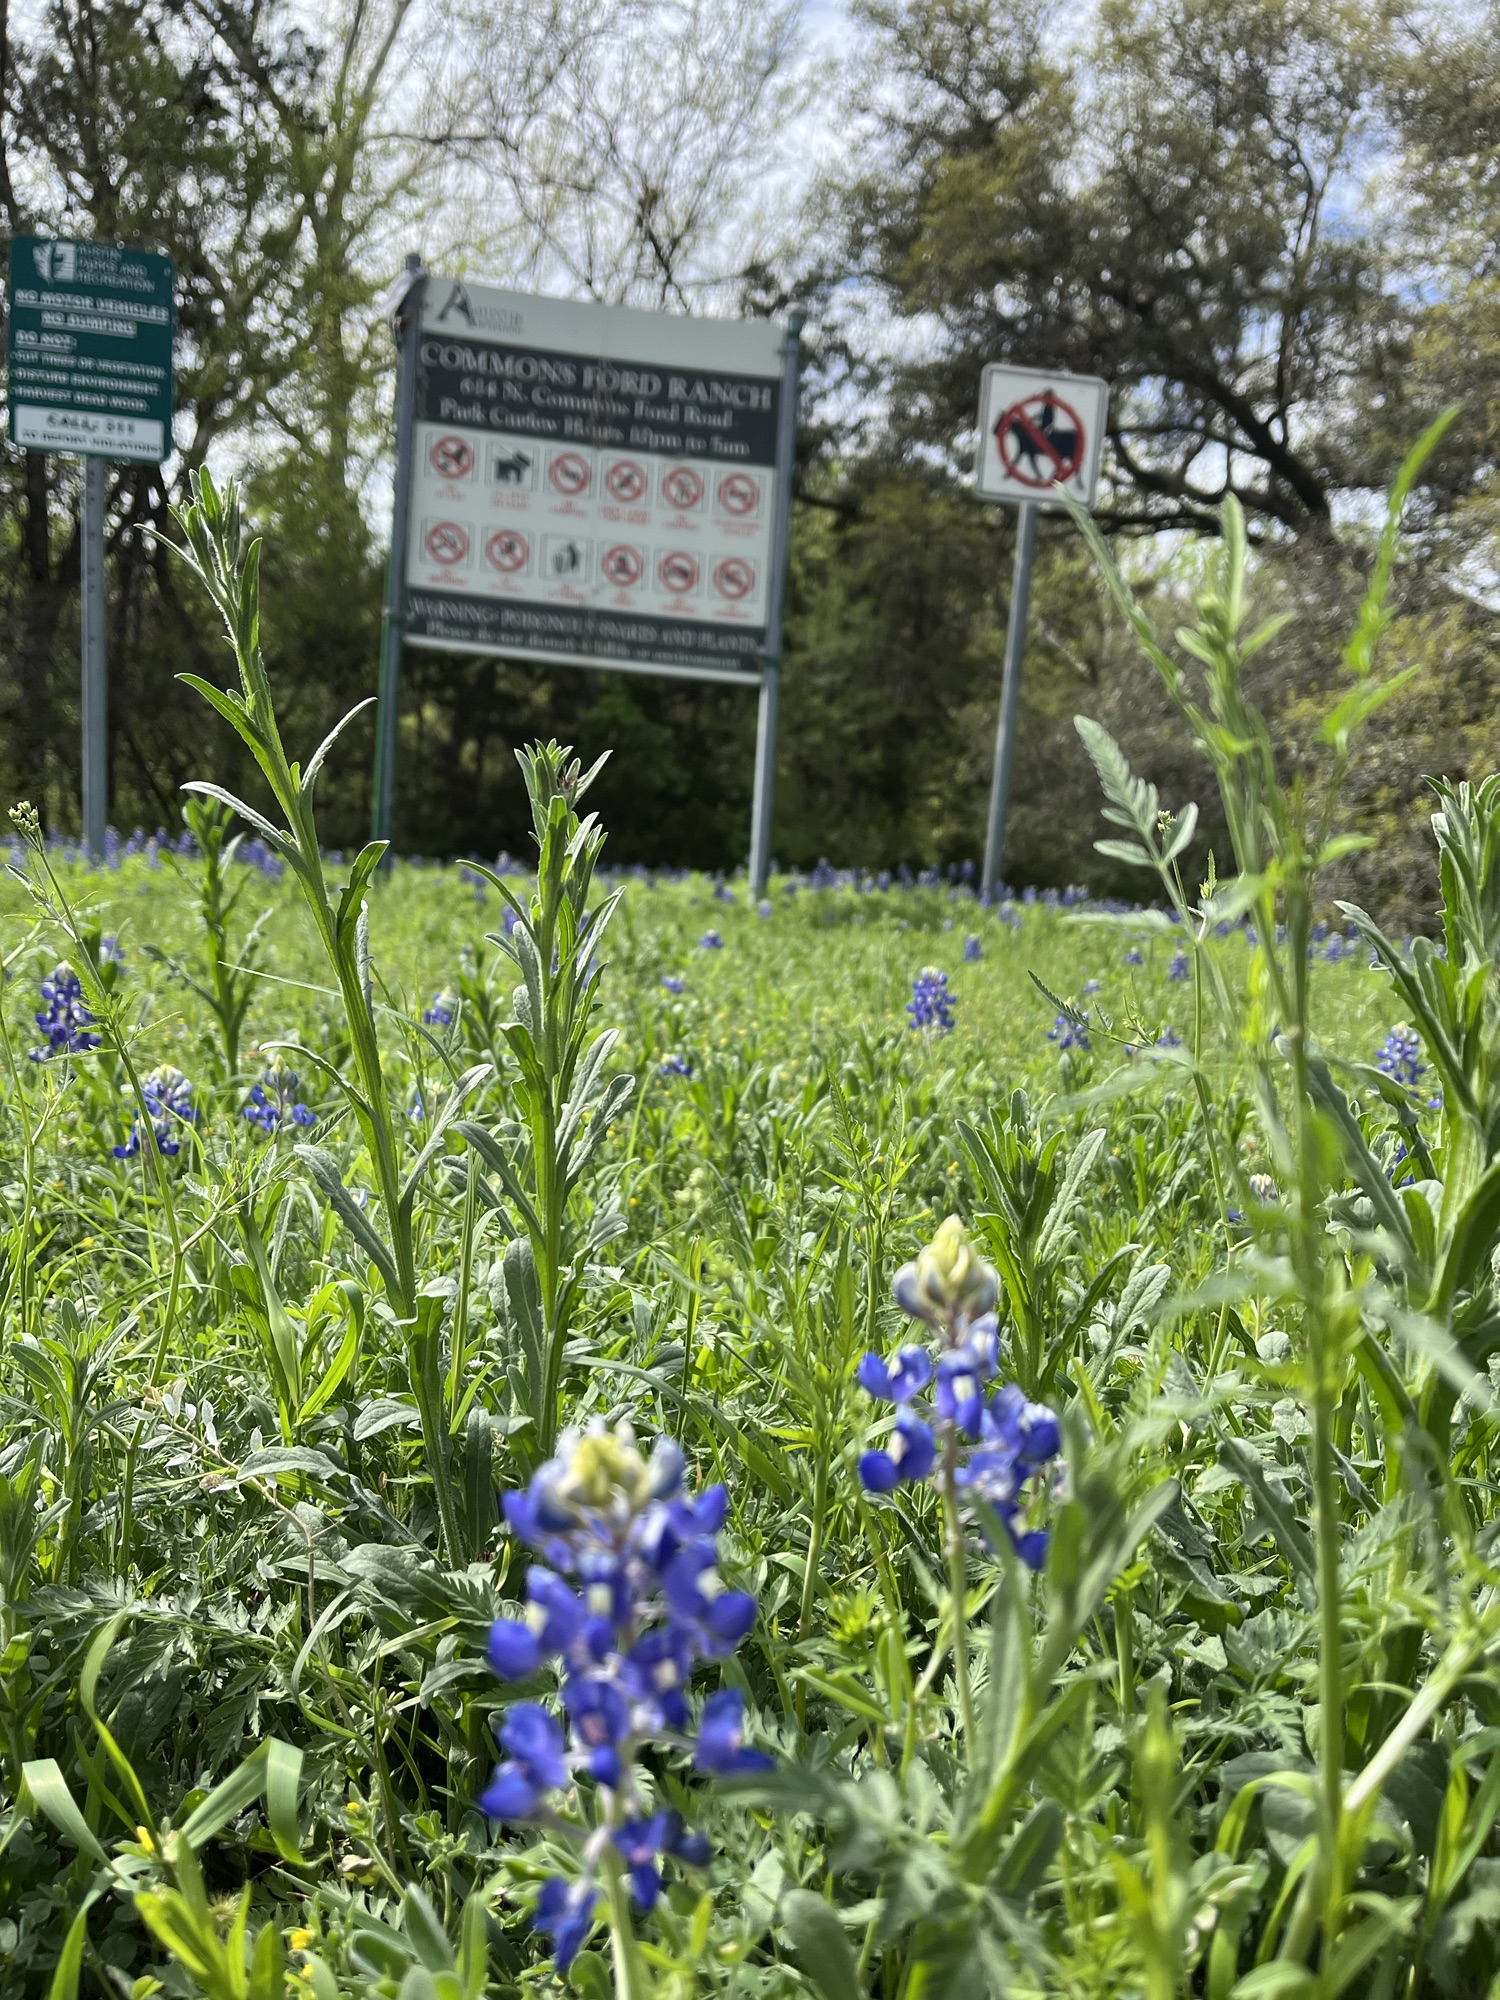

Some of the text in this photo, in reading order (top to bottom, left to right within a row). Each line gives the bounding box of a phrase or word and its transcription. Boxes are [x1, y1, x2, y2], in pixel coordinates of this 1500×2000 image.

[15, 289, 169, 320] NO MOTOR VEHICLES
[41, 311, 137, 333] NO DUMPING
[420, 342, 772, 409] COMMONS FORD RANCH
[503, 381, 528, 402] N.
[531, 385, 630, 416] Commons
[634, 400, 679, 422] Ford
[685, 405, 733, 428] Road
[440, 398, 486, 423] Park
[489, 402, 558, 433] Curfew
[564, 416, 624, 441] Hours
[630, 426, 681, 450] 10pm
[685, 434, 706, 452] to
[663, 627, 696, 647] AND
